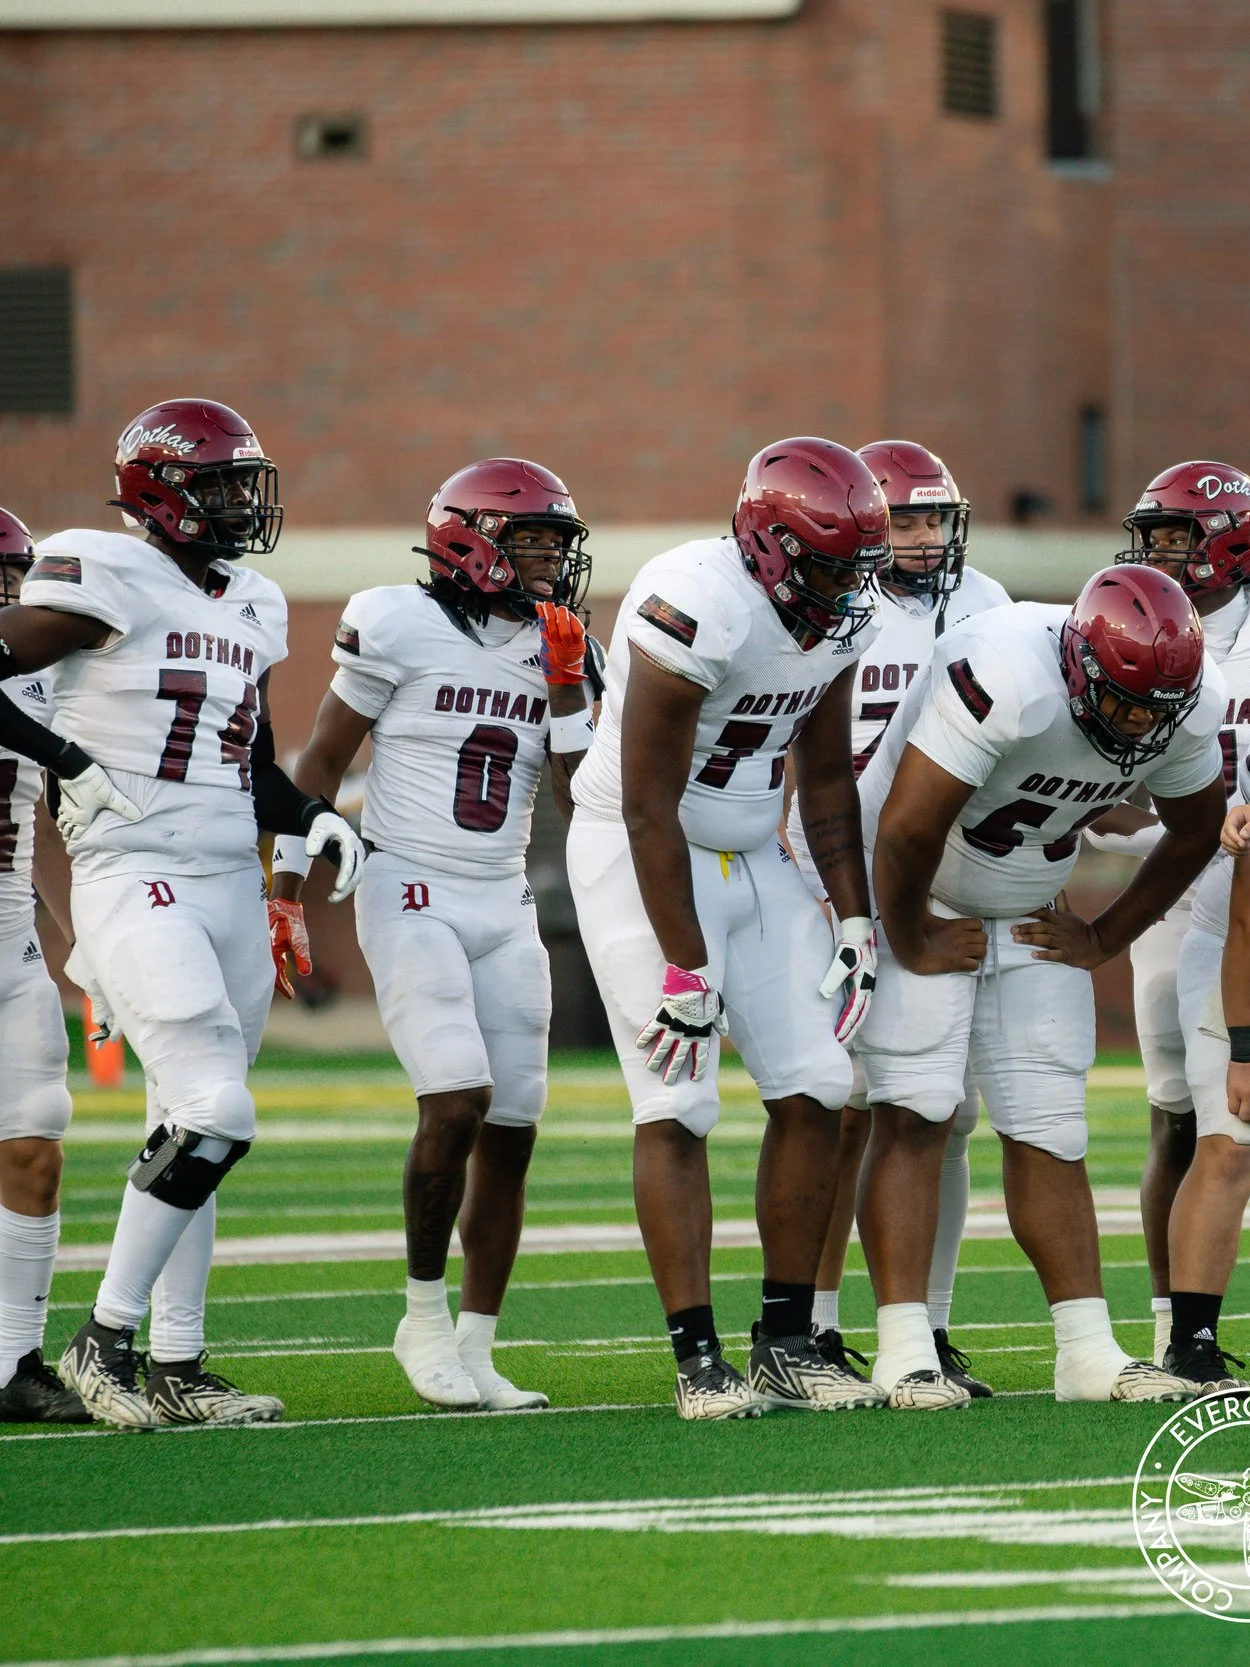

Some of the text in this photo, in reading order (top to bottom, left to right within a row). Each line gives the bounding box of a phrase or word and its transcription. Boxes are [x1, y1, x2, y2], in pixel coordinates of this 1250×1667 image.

[122, 423, 197, 456] Dothan
[917, 489, 946, 498] Riddell
[166, 631, 254, 676] DOTHAN
[861, 663, 919, 692] DOT
[22, 690, 47, 704] adidas
[434, 685, 549, 725] DOTHAN
[1153, 689, 1185, 700] Riddell
[156, 668, 259, 792] 74
[453, 723, 519, 834] 0
[1017, 772, 1136, 803] DOTHAN
[138, 879, 176, 910] D
[401, 881, 431, 912] D
